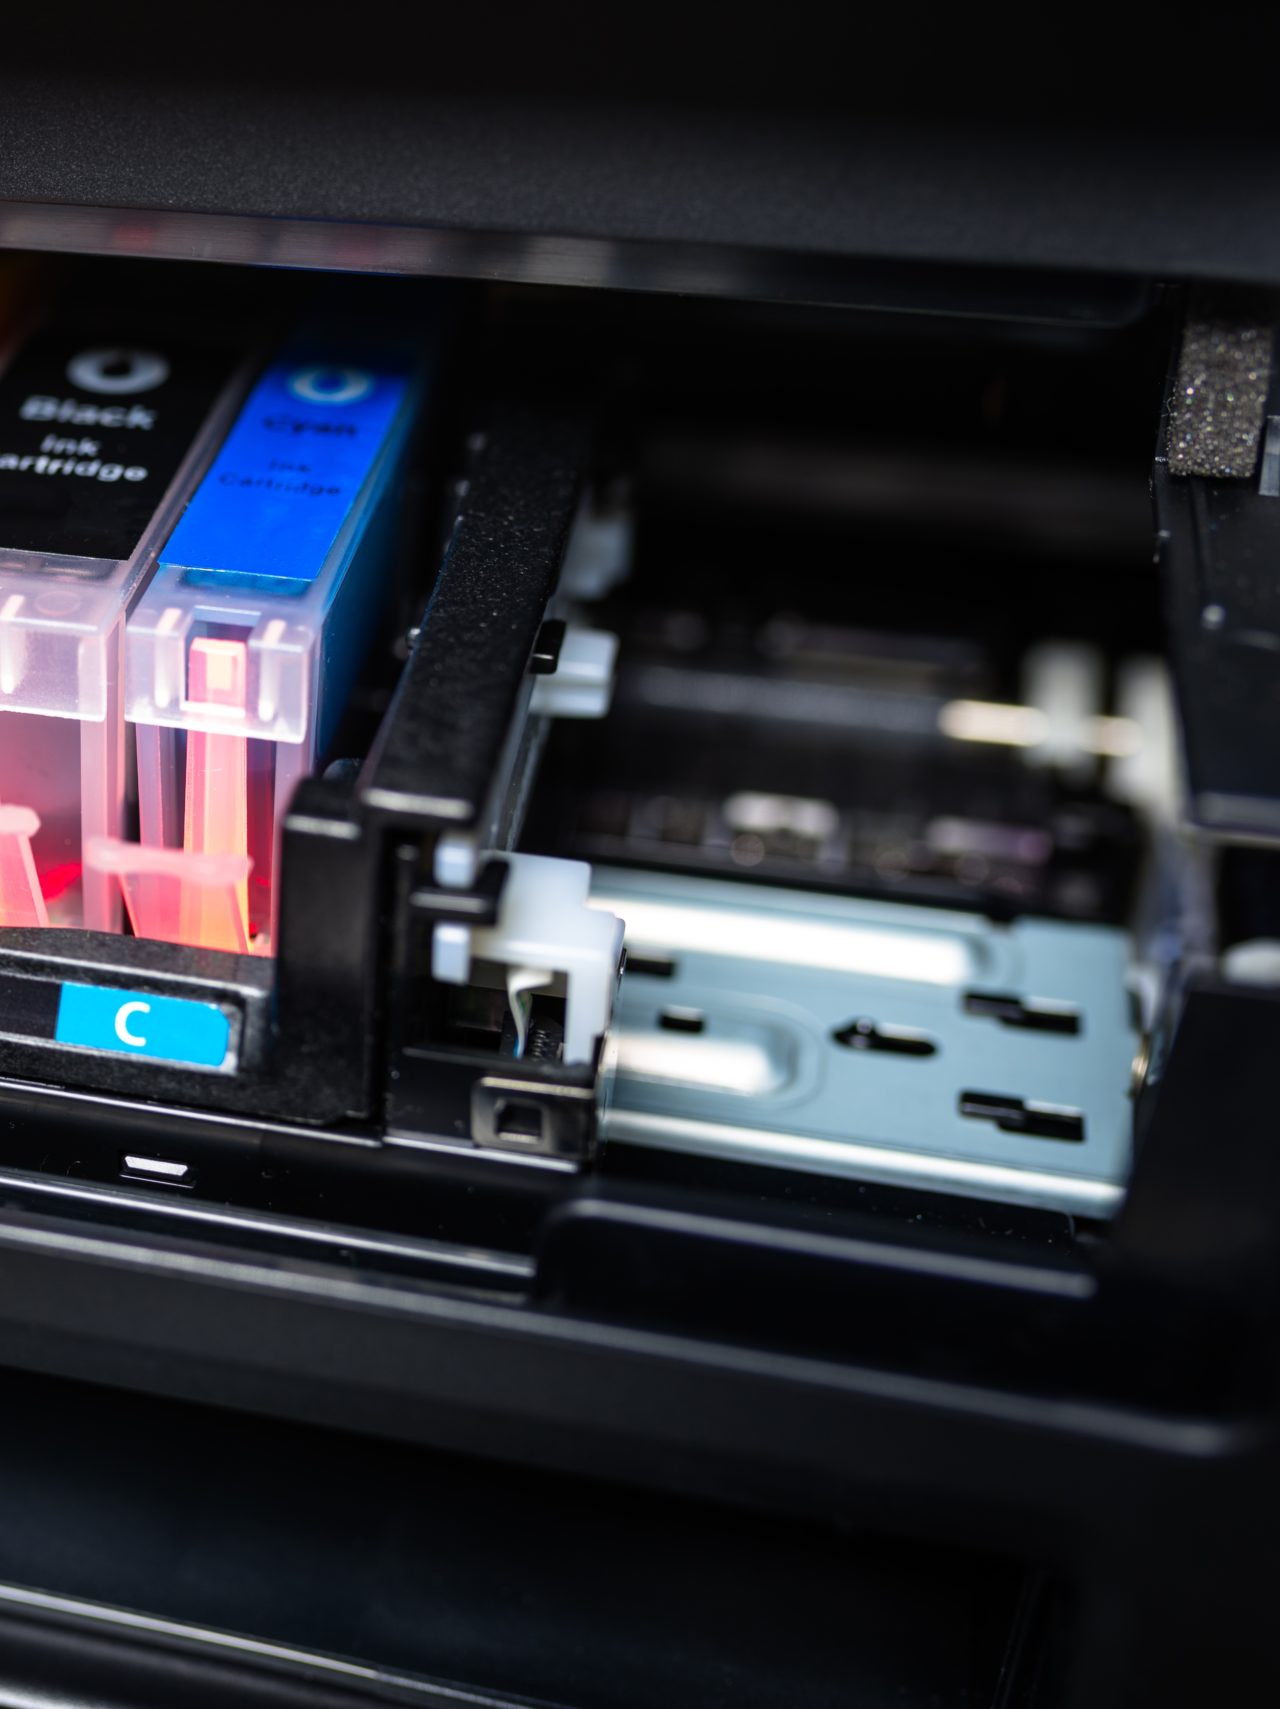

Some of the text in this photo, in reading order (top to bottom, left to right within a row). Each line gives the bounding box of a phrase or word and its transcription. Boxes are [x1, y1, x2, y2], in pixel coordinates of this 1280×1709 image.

[19, 395, 157, 430] Black
[40, 433, 101, 456] Ink
[114, 1001, 151, 1046] C
